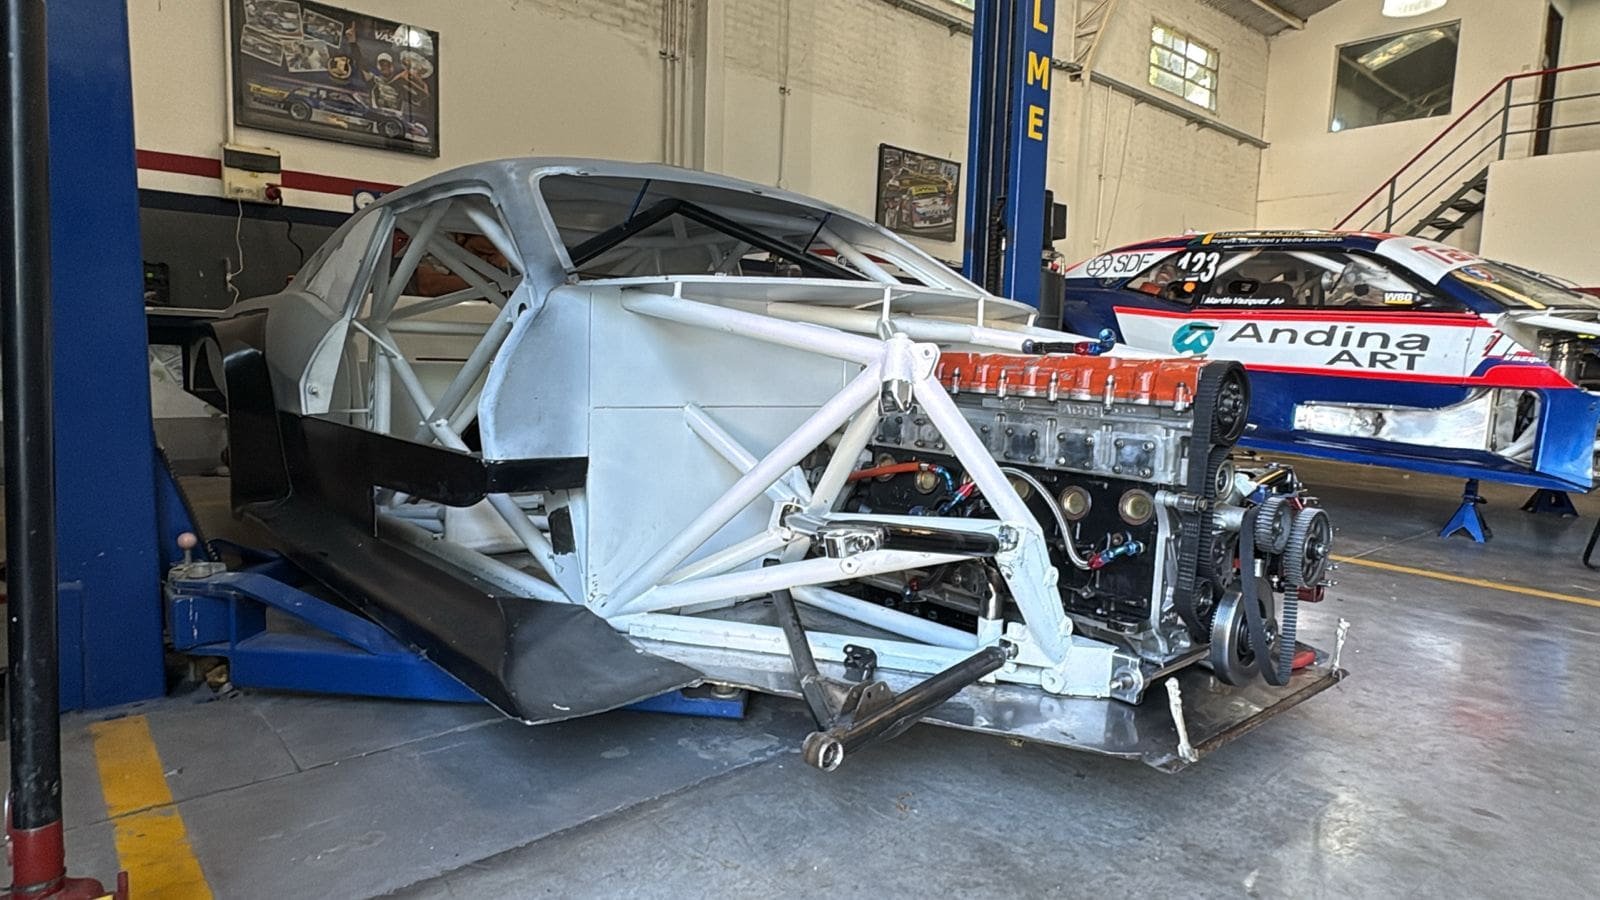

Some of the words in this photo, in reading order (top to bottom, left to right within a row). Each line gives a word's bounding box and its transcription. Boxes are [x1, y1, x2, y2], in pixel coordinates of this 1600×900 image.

[1113, 253, 1154, 273] SDF
[1177, 251, 1221, 283] 123
[1228, 322, 1431, 351] Andina
[1325, 349, 1426, 371] ART
